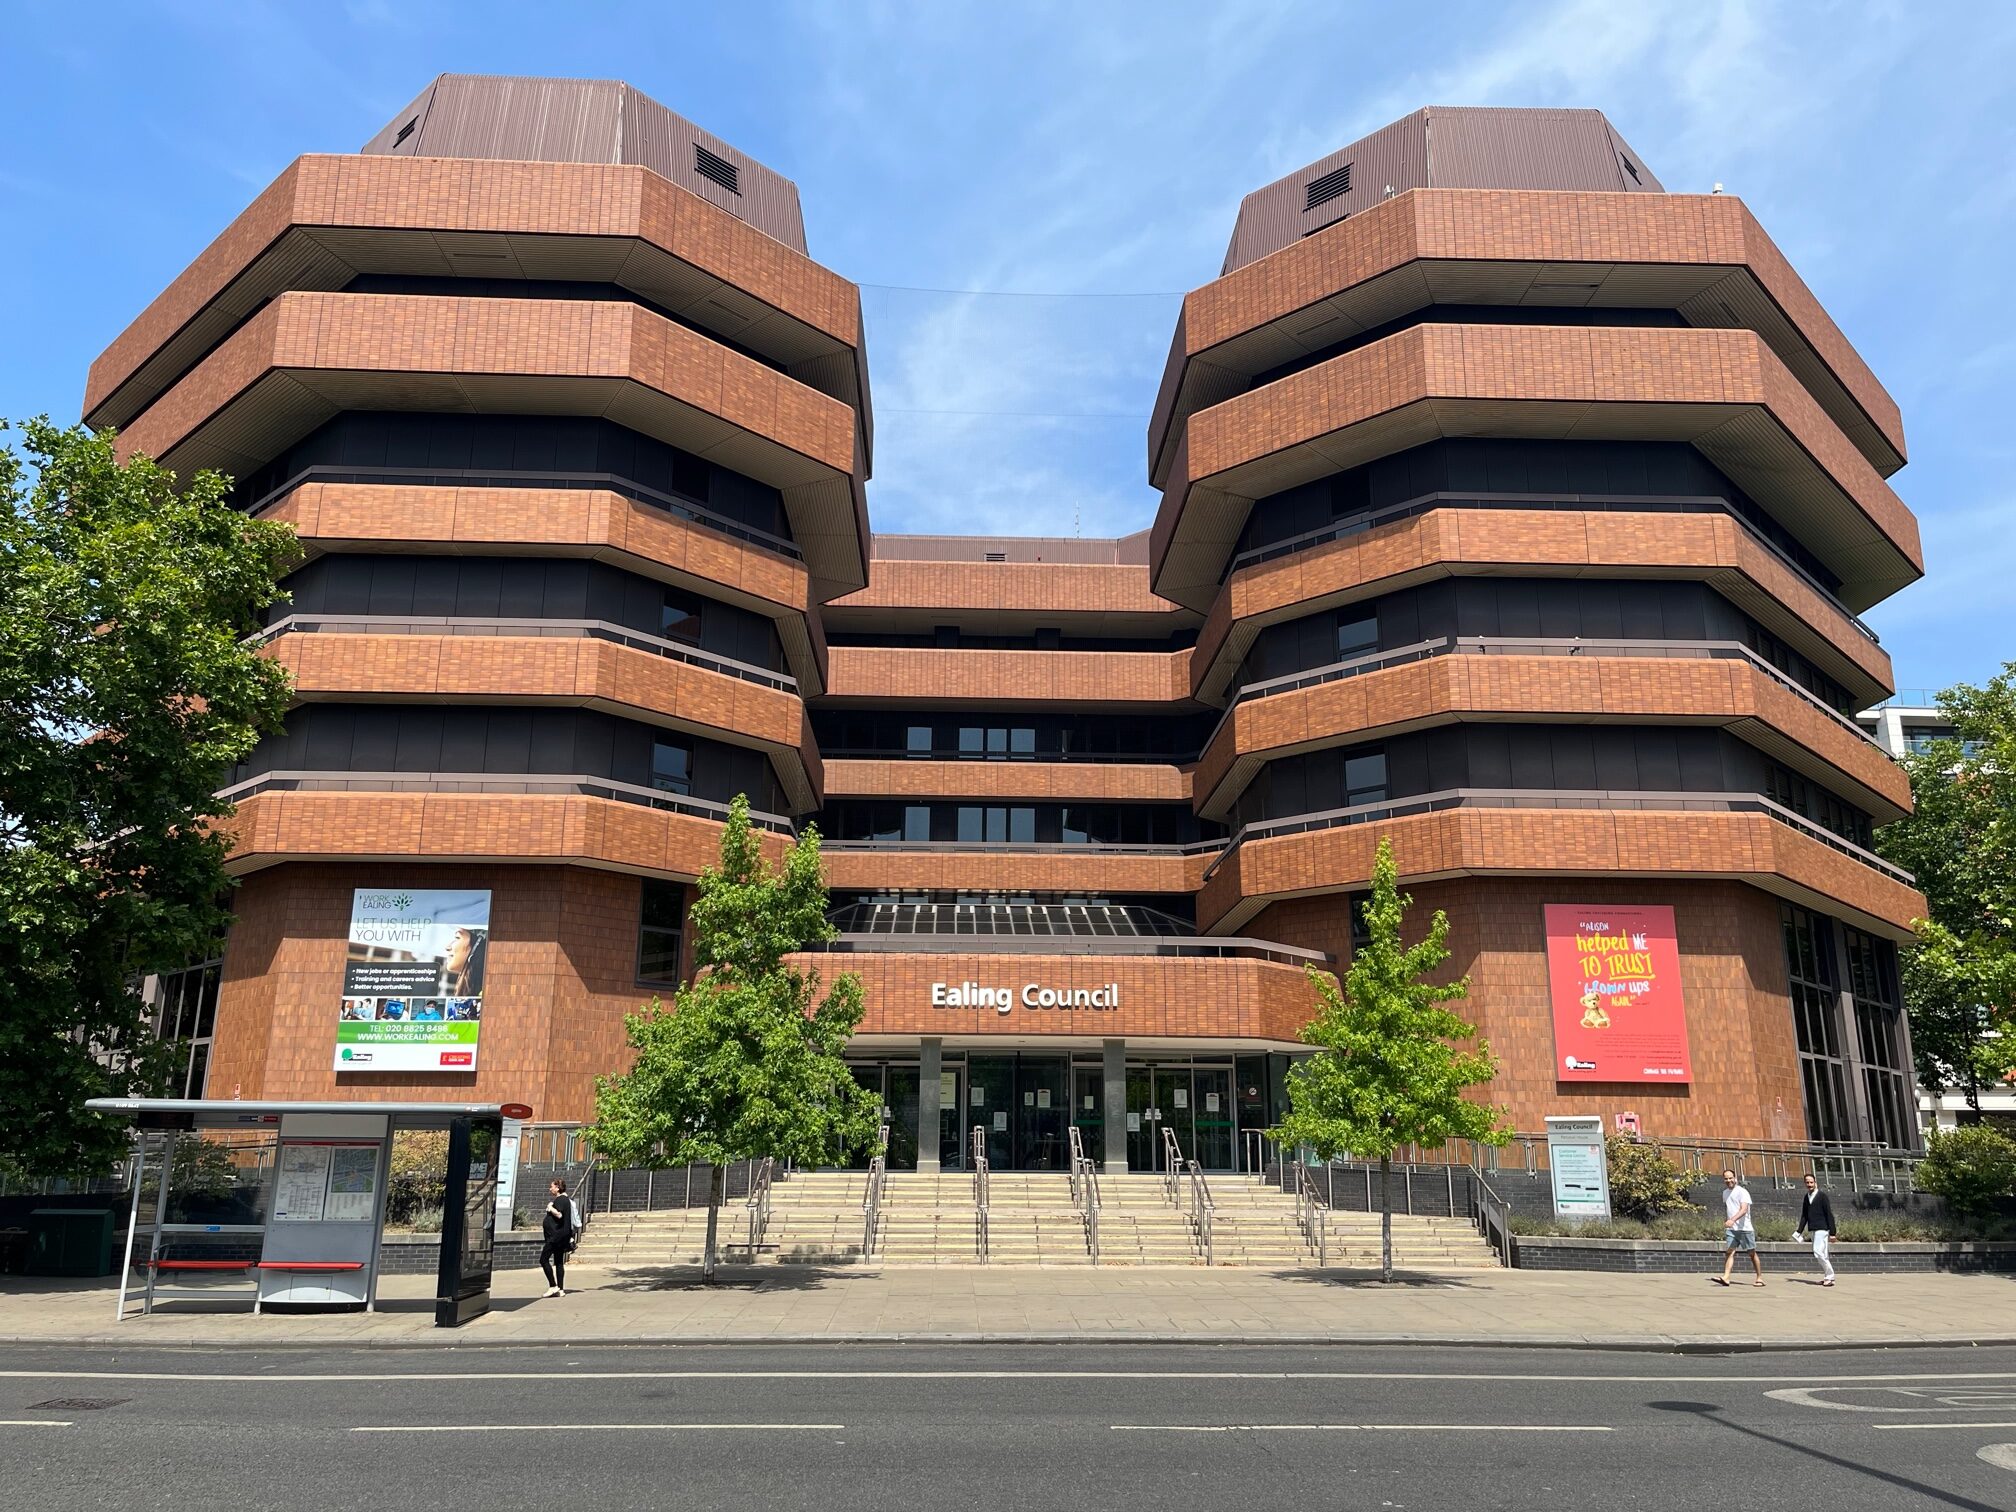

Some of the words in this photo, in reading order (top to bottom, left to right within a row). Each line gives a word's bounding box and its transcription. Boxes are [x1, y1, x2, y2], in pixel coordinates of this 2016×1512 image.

[362, 901, 392, 909] EALING
[356, 917, 377, 929] LET
[380, 917, 398, 929] US
[401, 917, 432, 930] HELP
[355, 929, 384, 941] YOU
[388, 930, 421, 941] WITH
[1576, 928, 1629, 956] helped
[1632, 933, 1648, 950] ME
[1579, 955, 1601, 978] TO
[1605, 952, 1653, 976] TRUST
[931, 981, 1012, 1013] Ealing
[1021, 983, 1118, 1008] Council
[385, 1024, 401, 1032] 020
[403, 1024, 424, 1032] 8825
[357, 1033, 459, 1041] WWW.WORKEALING.COM
